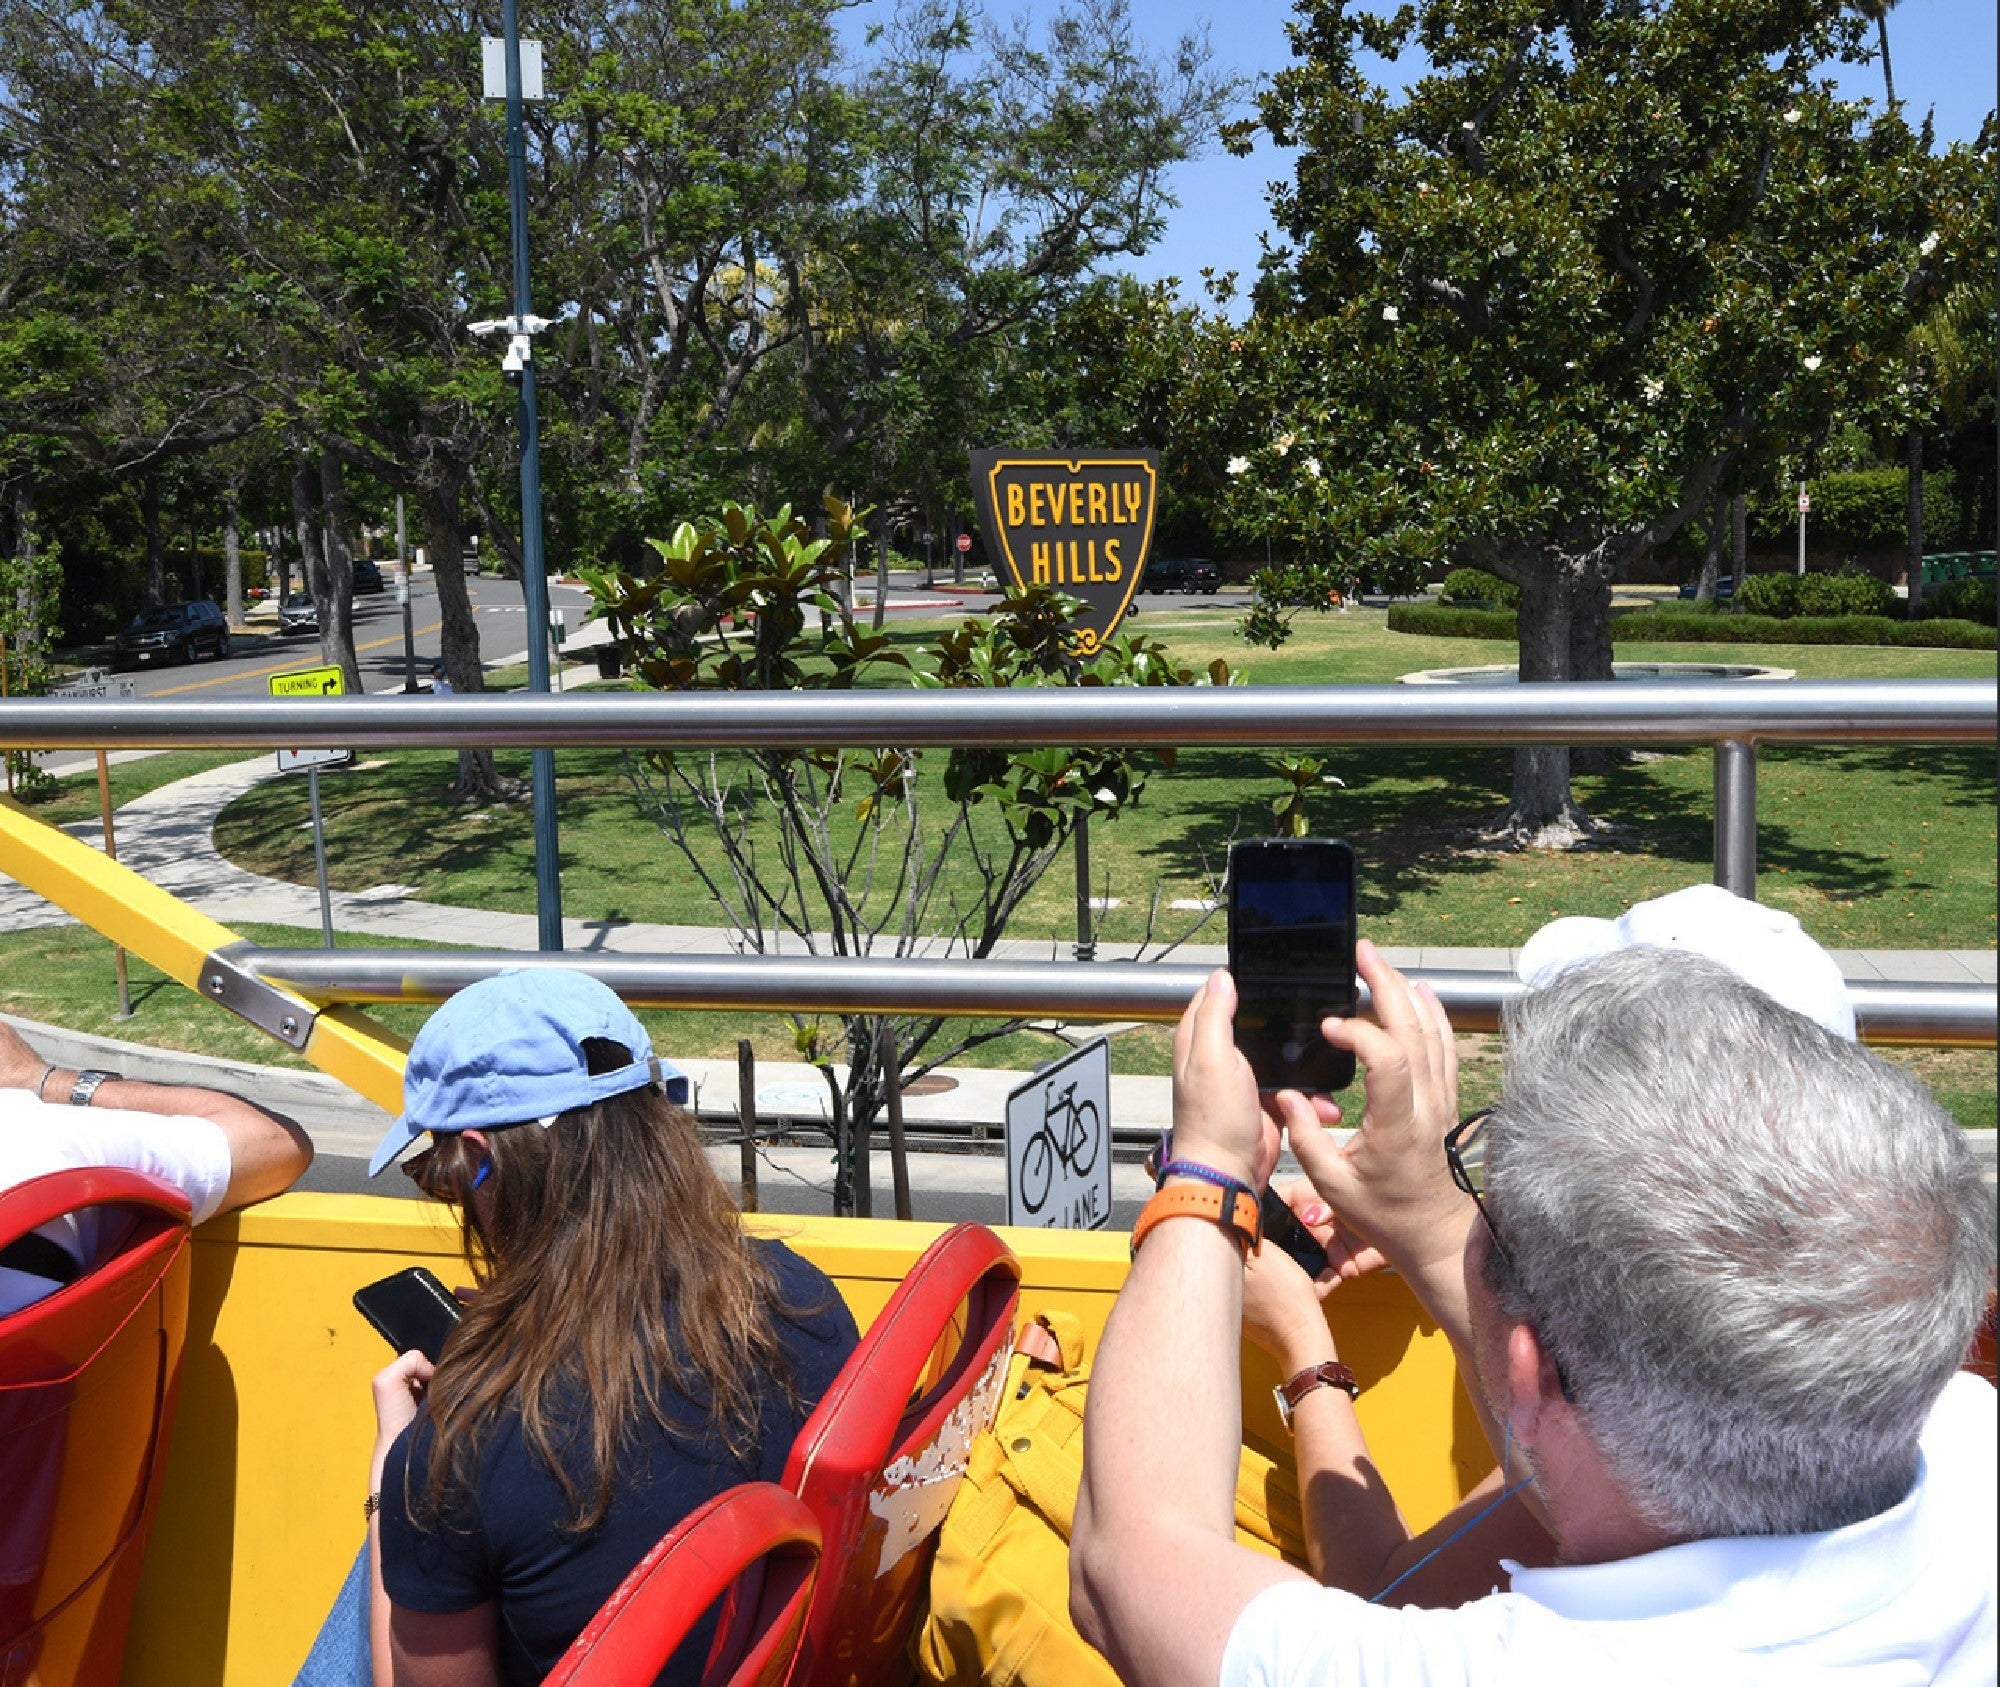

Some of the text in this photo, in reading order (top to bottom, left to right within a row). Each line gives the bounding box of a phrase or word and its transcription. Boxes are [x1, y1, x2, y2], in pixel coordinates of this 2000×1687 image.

[1007, 482, 1142, 527] BEVERLY
[1031, 538, 1123, 585] HILLS
[277, 677, 318, 695] TURNING
